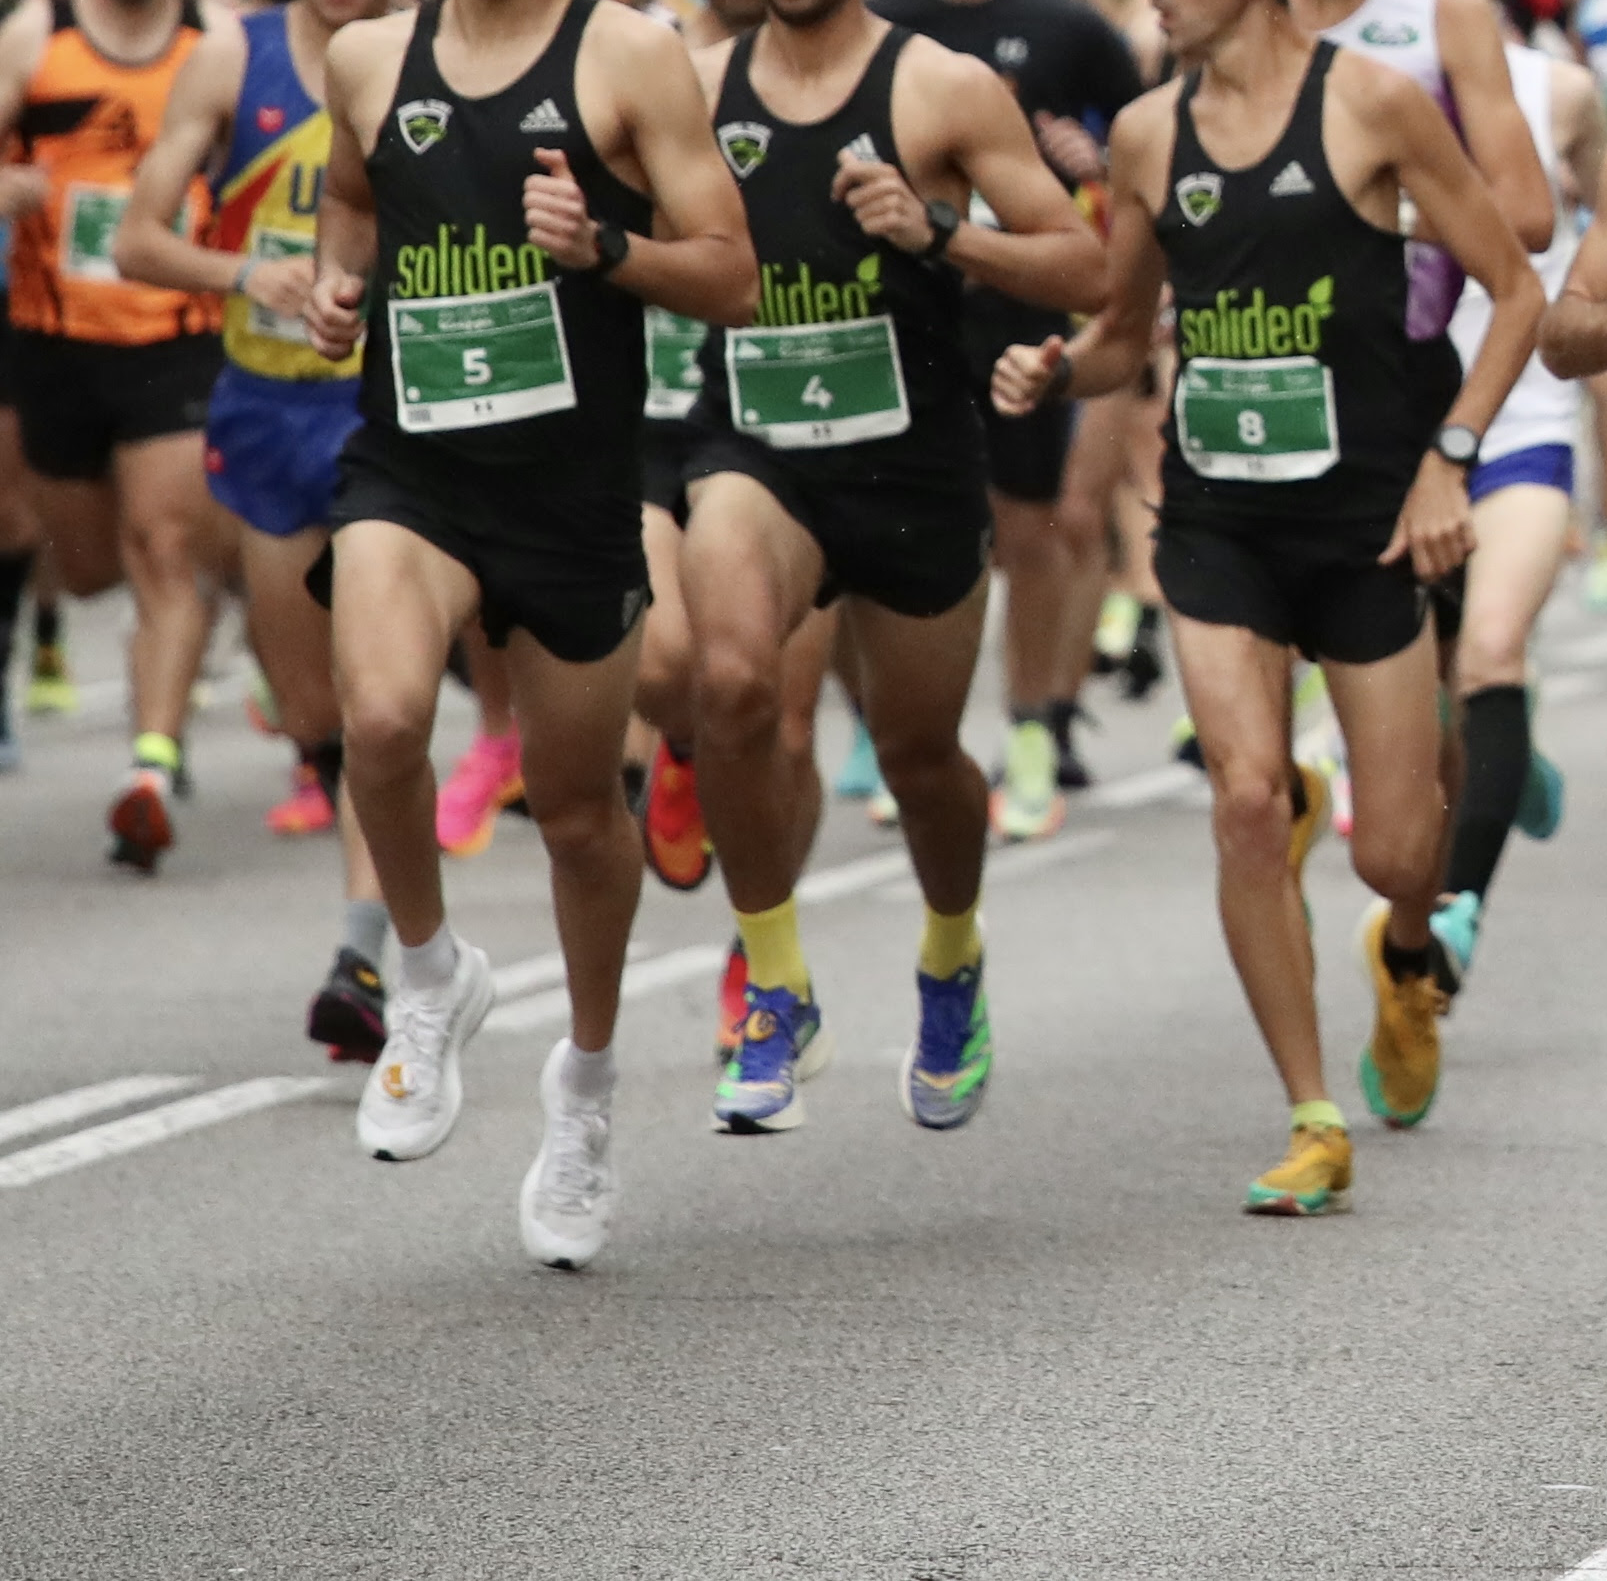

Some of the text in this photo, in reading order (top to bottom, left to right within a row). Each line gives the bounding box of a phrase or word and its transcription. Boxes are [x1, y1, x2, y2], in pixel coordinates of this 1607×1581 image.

[755, 262, 869, 326] lideo
[1181, 287, 1320, 357] solideo
[463, 348, 493, 385] 5
[801, 374, 834, 410] 4
[1237, 410, 1266, 446] 8
